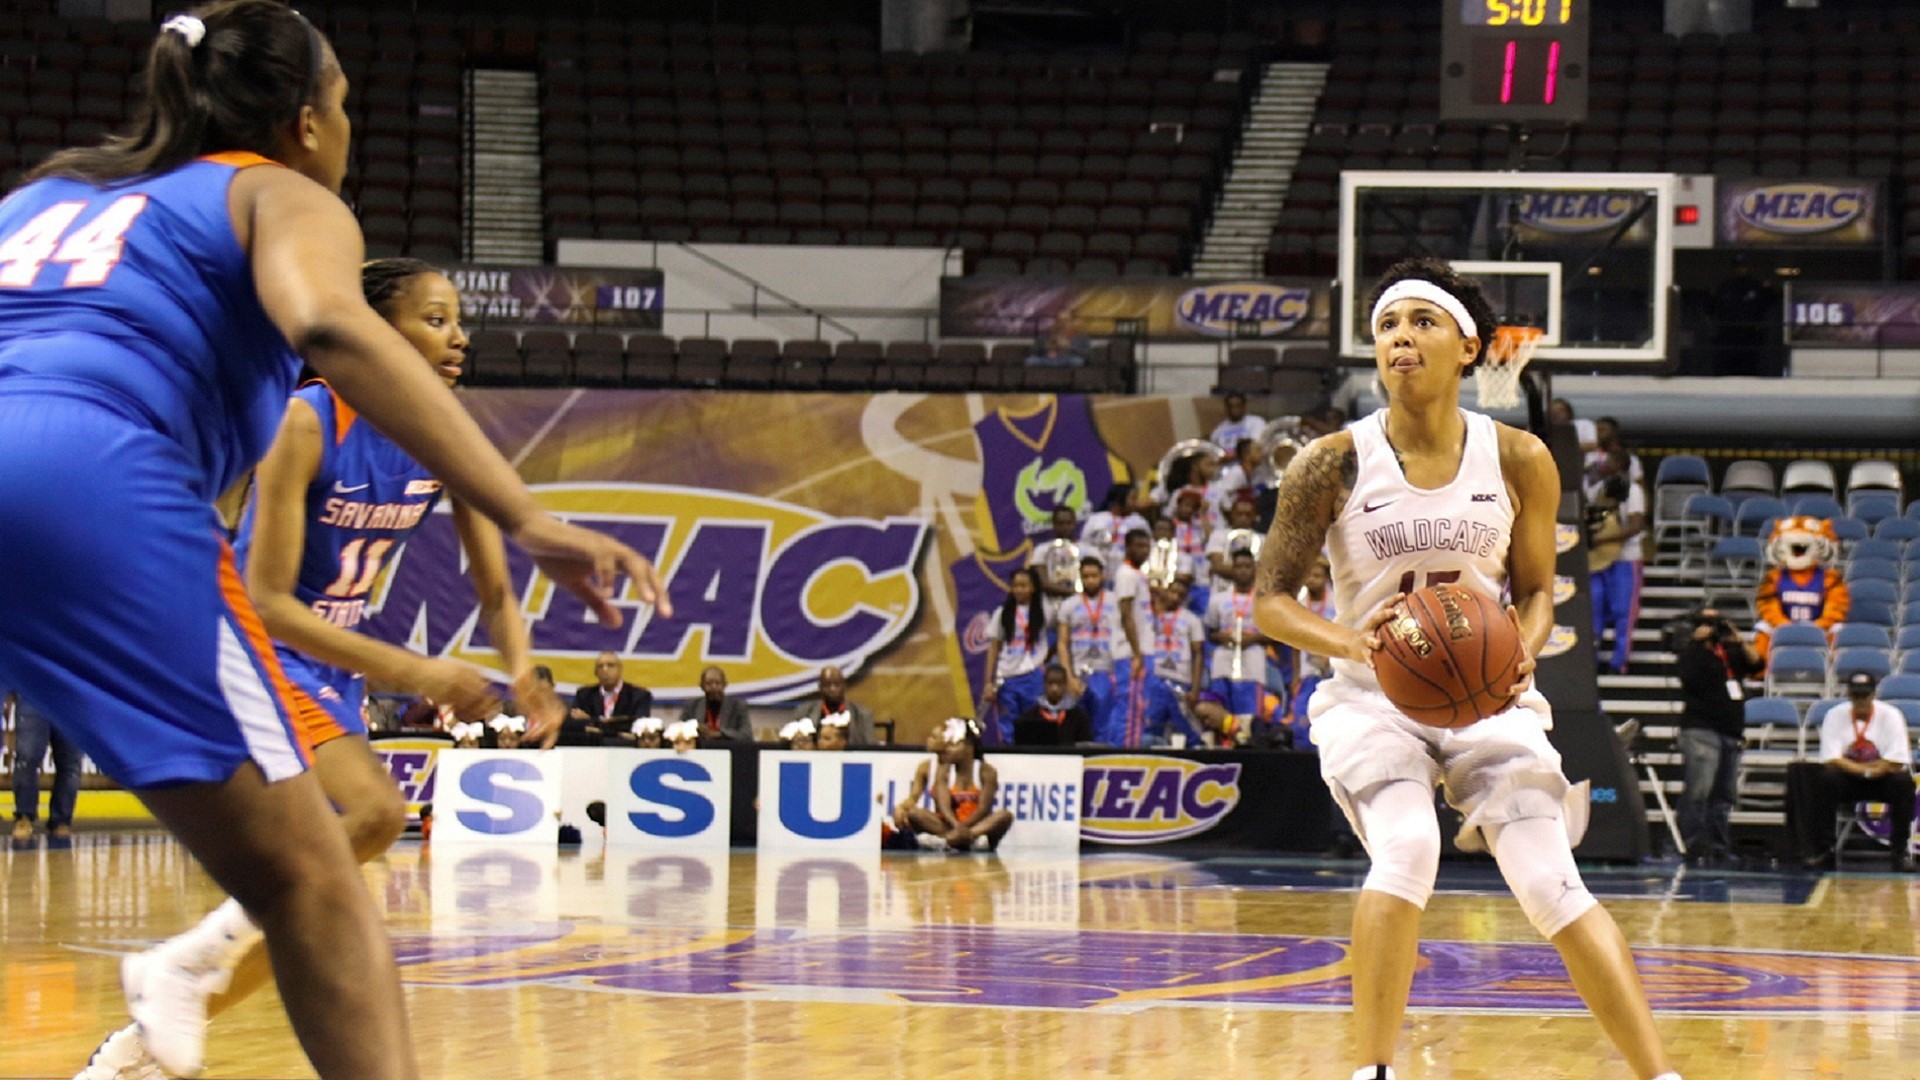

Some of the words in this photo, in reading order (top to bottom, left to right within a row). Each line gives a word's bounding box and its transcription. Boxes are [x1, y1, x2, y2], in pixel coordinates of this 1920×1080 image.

[1500, 40, 1560, 104] 11
[1523, 193, 1632, 219] MEAC
[1748, 192, 1858, 219] MEAC
[0, 192, 149, 287] 44
[455, 271, 511, 291] STATE
[612, 286, 657, 309] 107
[1186, 288, 1311, 323] MEAC
[1796, 303, 1842, 325] 106
[1365, 518, 1499, 560] WILDCATS
[324, 537, 396, 598] 11
[350, 510, 928, 662] MEAC
[456, 758, 545, 835] S
[627, 758, 716, 838] S
[778, 762, 873, 840] U
[1083, 765, 1240, 821] EAC
